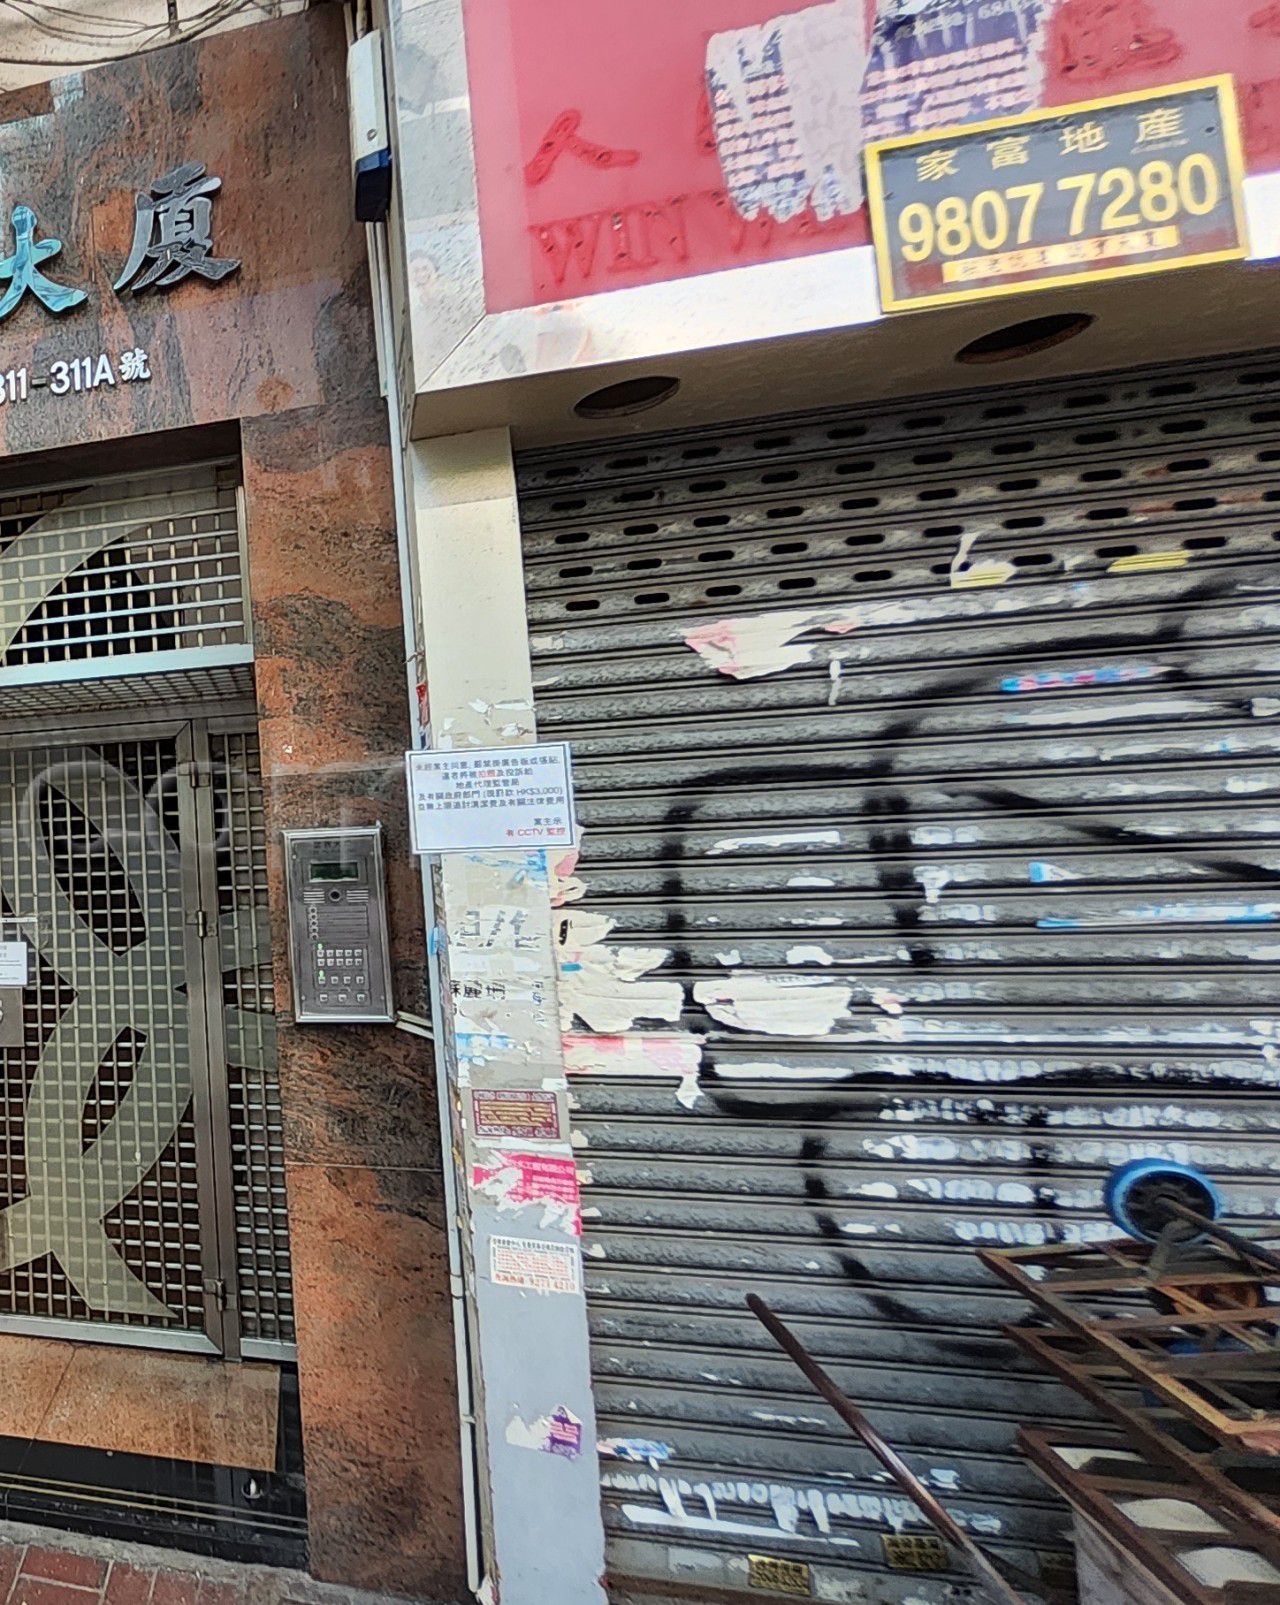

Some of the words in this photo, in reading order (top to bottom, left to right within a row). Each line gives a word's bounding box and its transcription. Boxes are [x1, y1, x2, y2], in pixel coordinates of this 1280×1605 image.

[916, 107, 1186, 182] 家富地產
[899, 182, 1045, 262] 9807
[1057, 152, 1219, 236] 7280
[517, 828, 544, 837] CCTV
